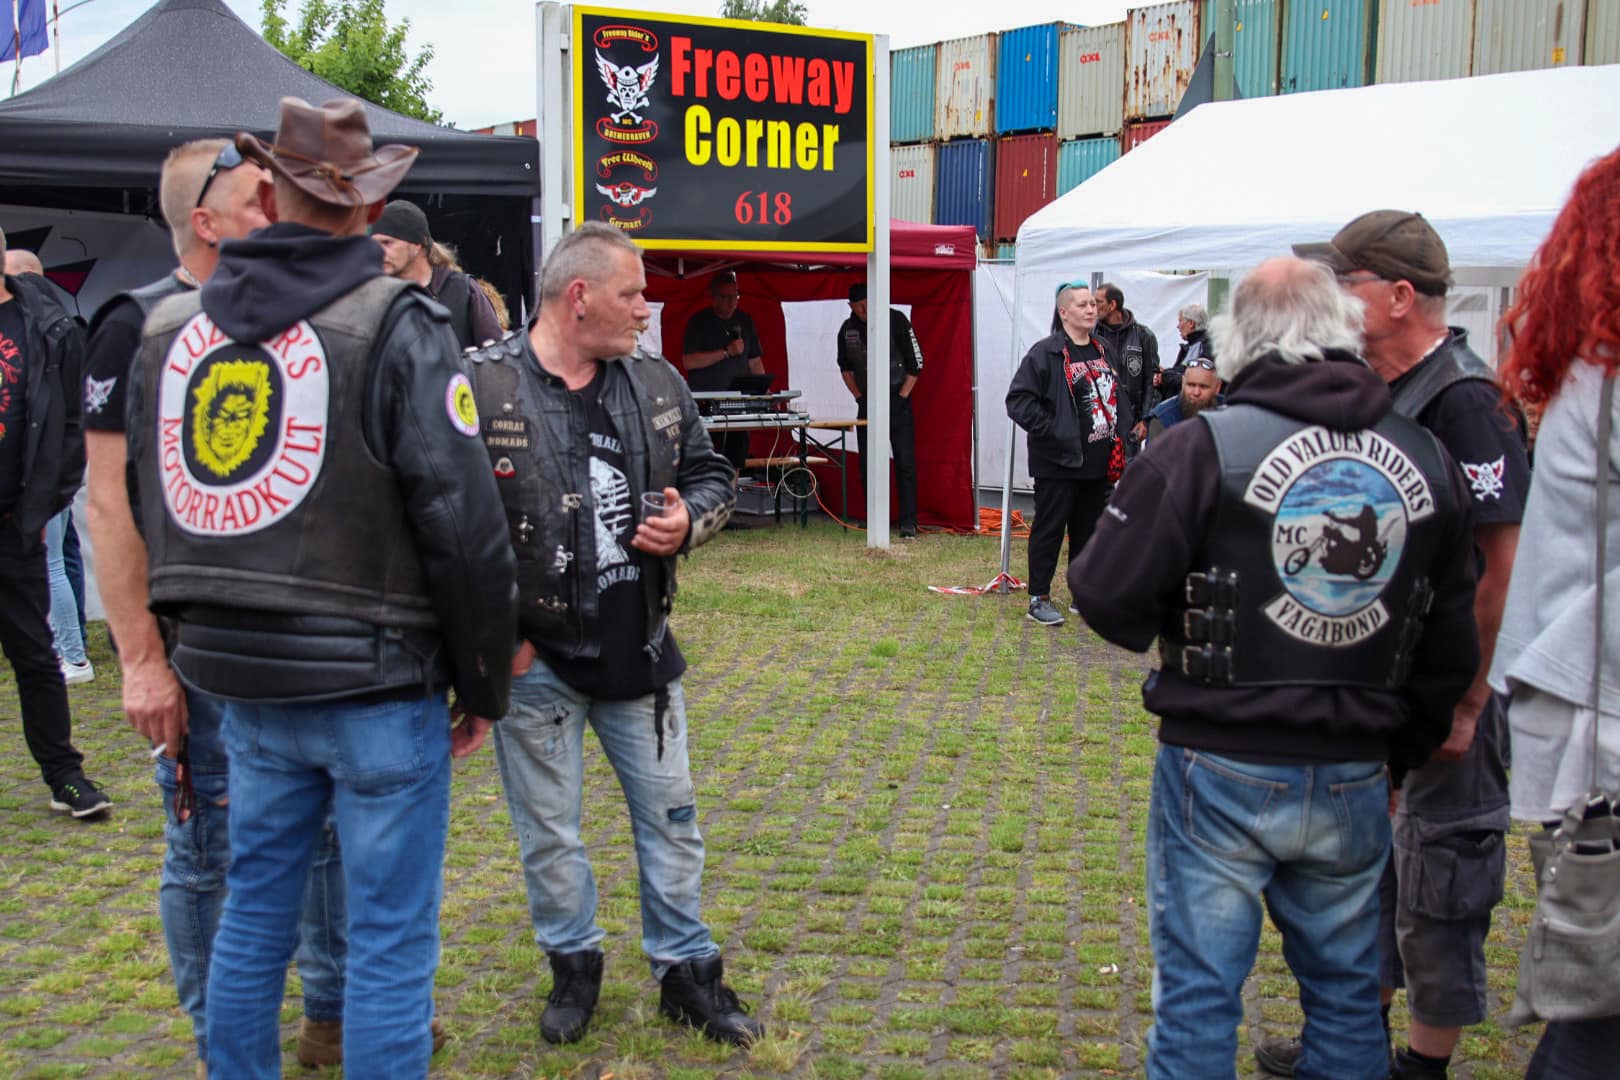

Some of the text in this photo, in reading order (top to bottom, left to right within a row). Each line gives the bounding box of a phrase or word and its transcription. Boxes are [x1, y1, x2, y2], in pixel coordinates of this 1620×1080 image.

[670, 36, 855, 114] Freeway
[684, 104, 839, 171] Corner
[735, 190, 793, 225] 618
[162, 417, 323, 531] MOTORRADKULT
[1253, 456, 1292, 502] OLD
[1368, 436, 1432, 513] RIDERS
[1276, 525, 1308, 545] MC
[1275, 601, 1382, 644] VAGABOND
